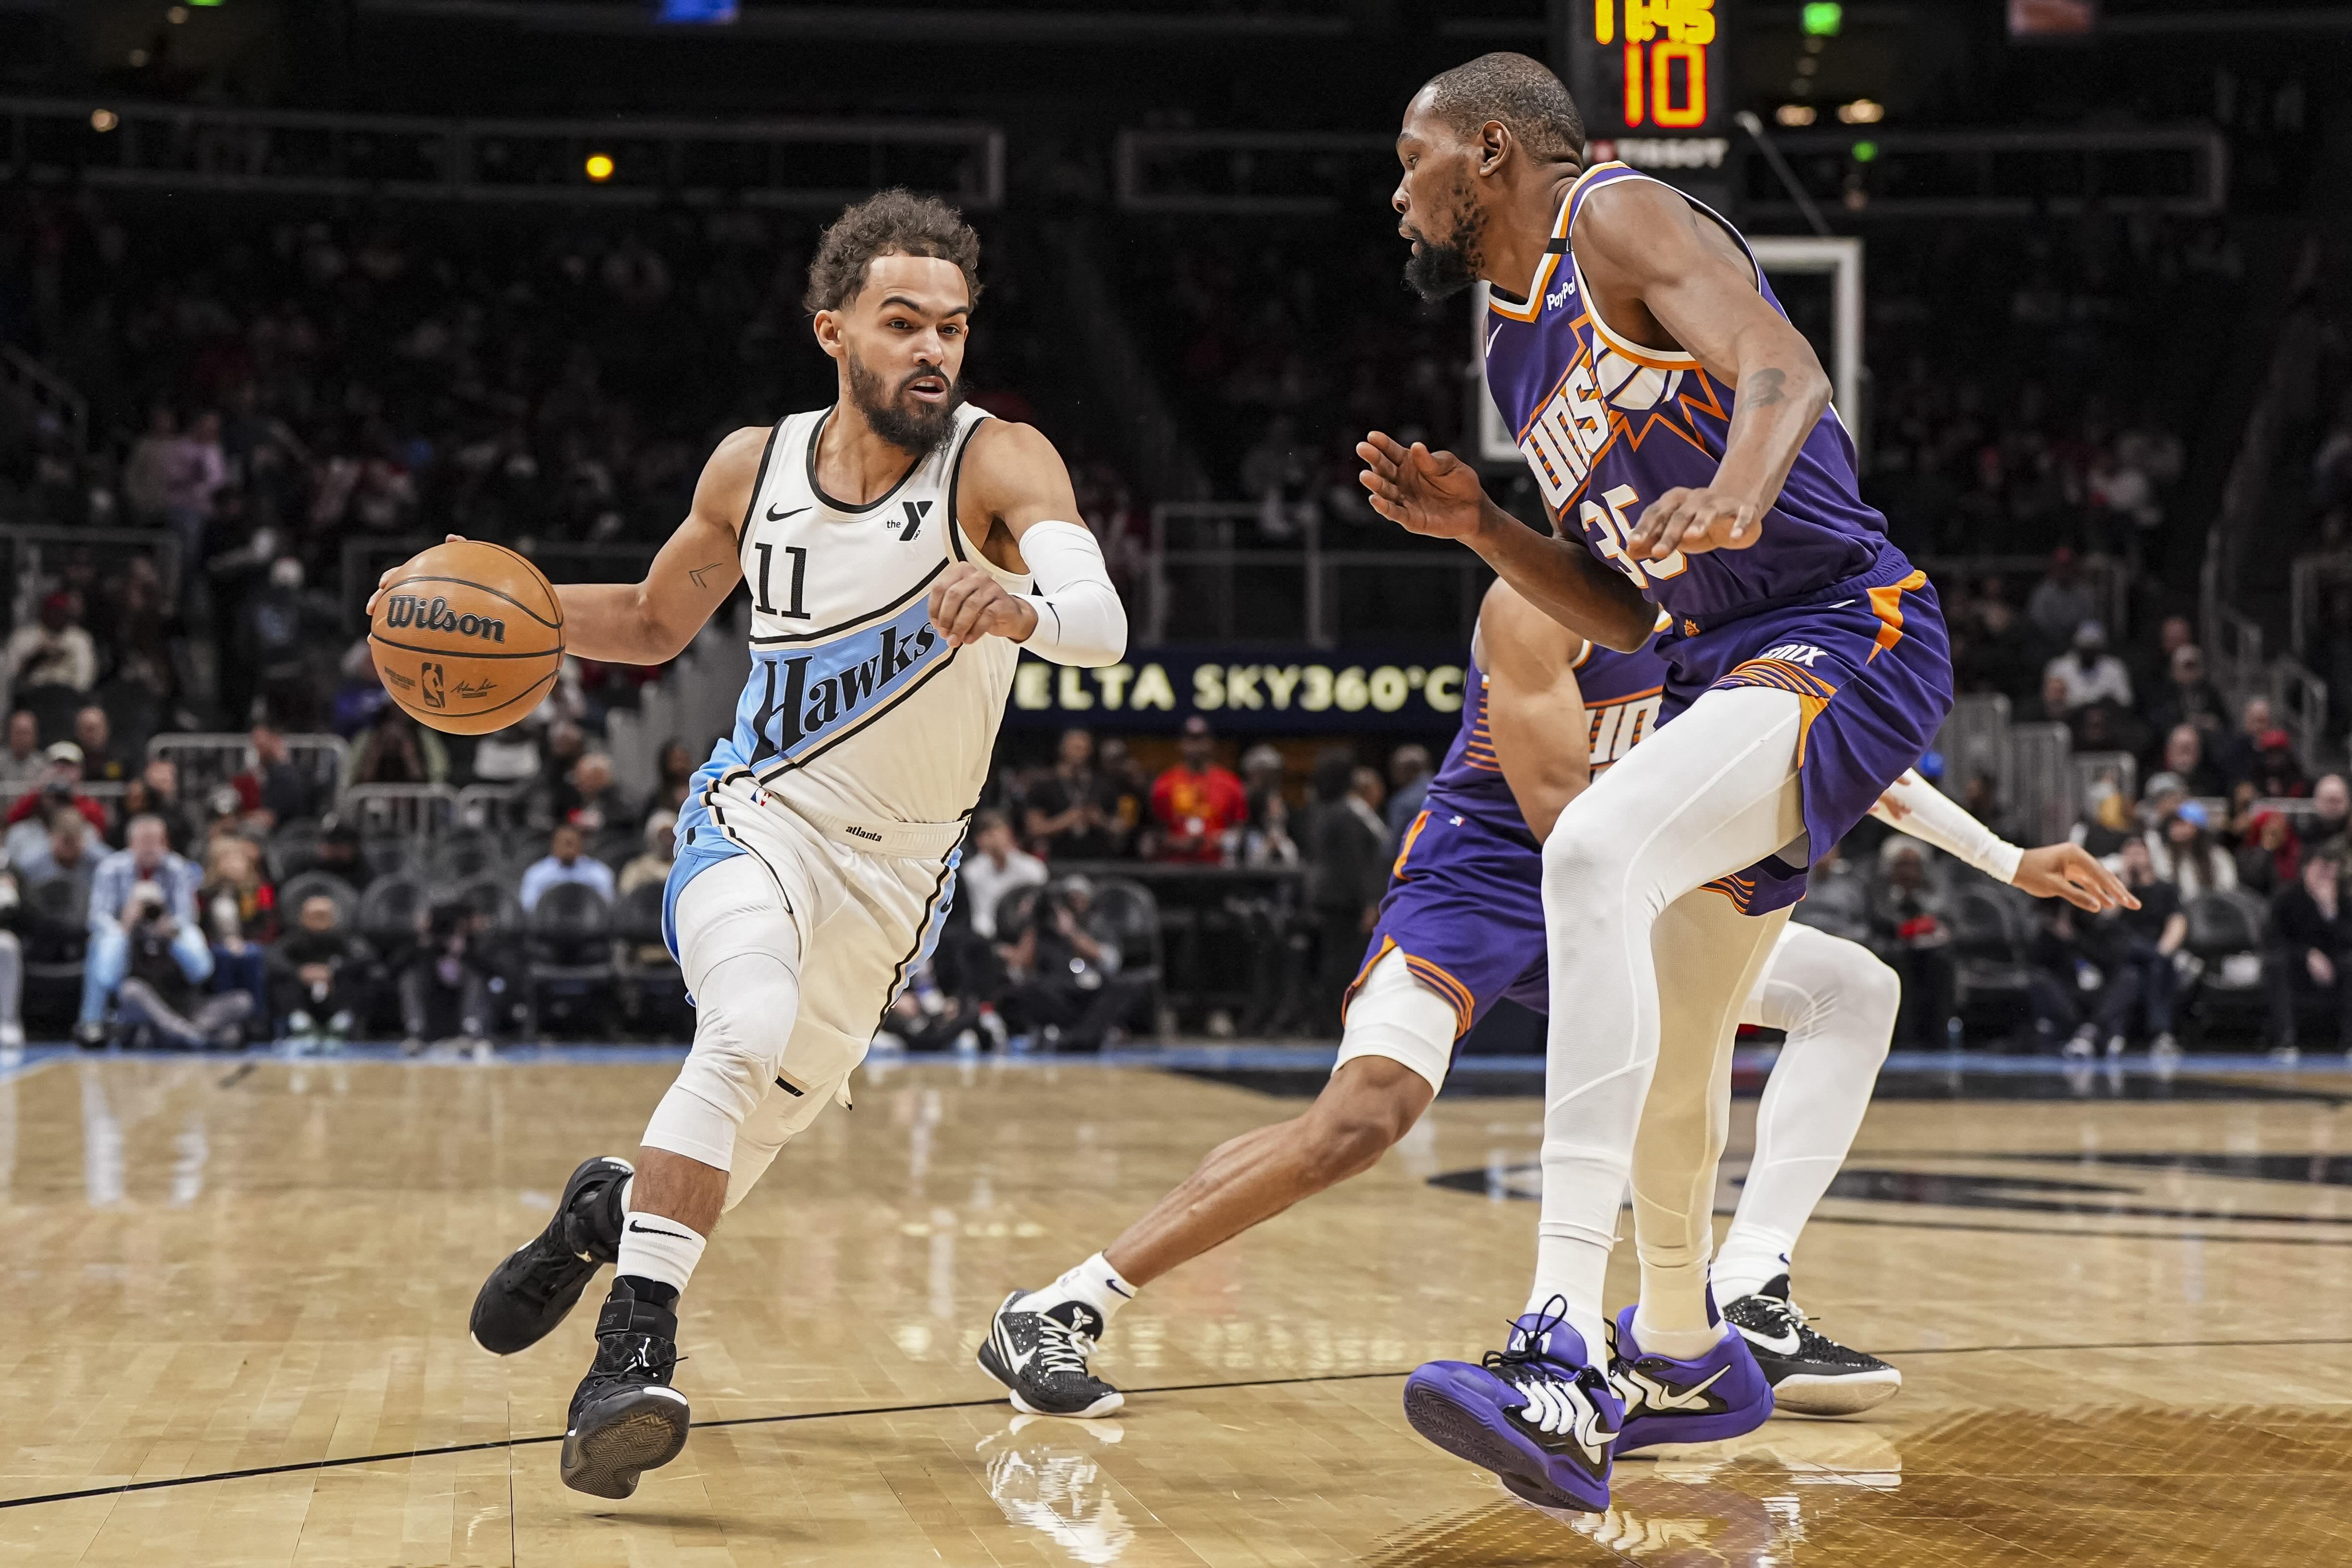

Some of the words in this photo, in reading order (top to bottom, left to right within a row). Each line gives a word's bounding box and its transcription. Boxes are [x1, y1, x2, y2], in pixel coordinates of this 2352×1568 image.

[1624, 39, 1707, 128] 10
[1547, 276, 1575, 311] PayPal
[1520, 364, 1610, 510] UNS
[887, 520, 901, 528] the
[913, 530, 921, 540] YMCA
[1580, 484, 1688, 588] 35
[755, 542, 811, 620] 11
[387, 595, 505, 644] Wilson
[1759, 644, 1829, 667] NIX
[749, 621, 937, 768] Hawks
[1014, 662, 1174, 711] ELTA
[1192, 663, 1465, 712] SKY360°C
[846, 826, 882, 842] atlanta
